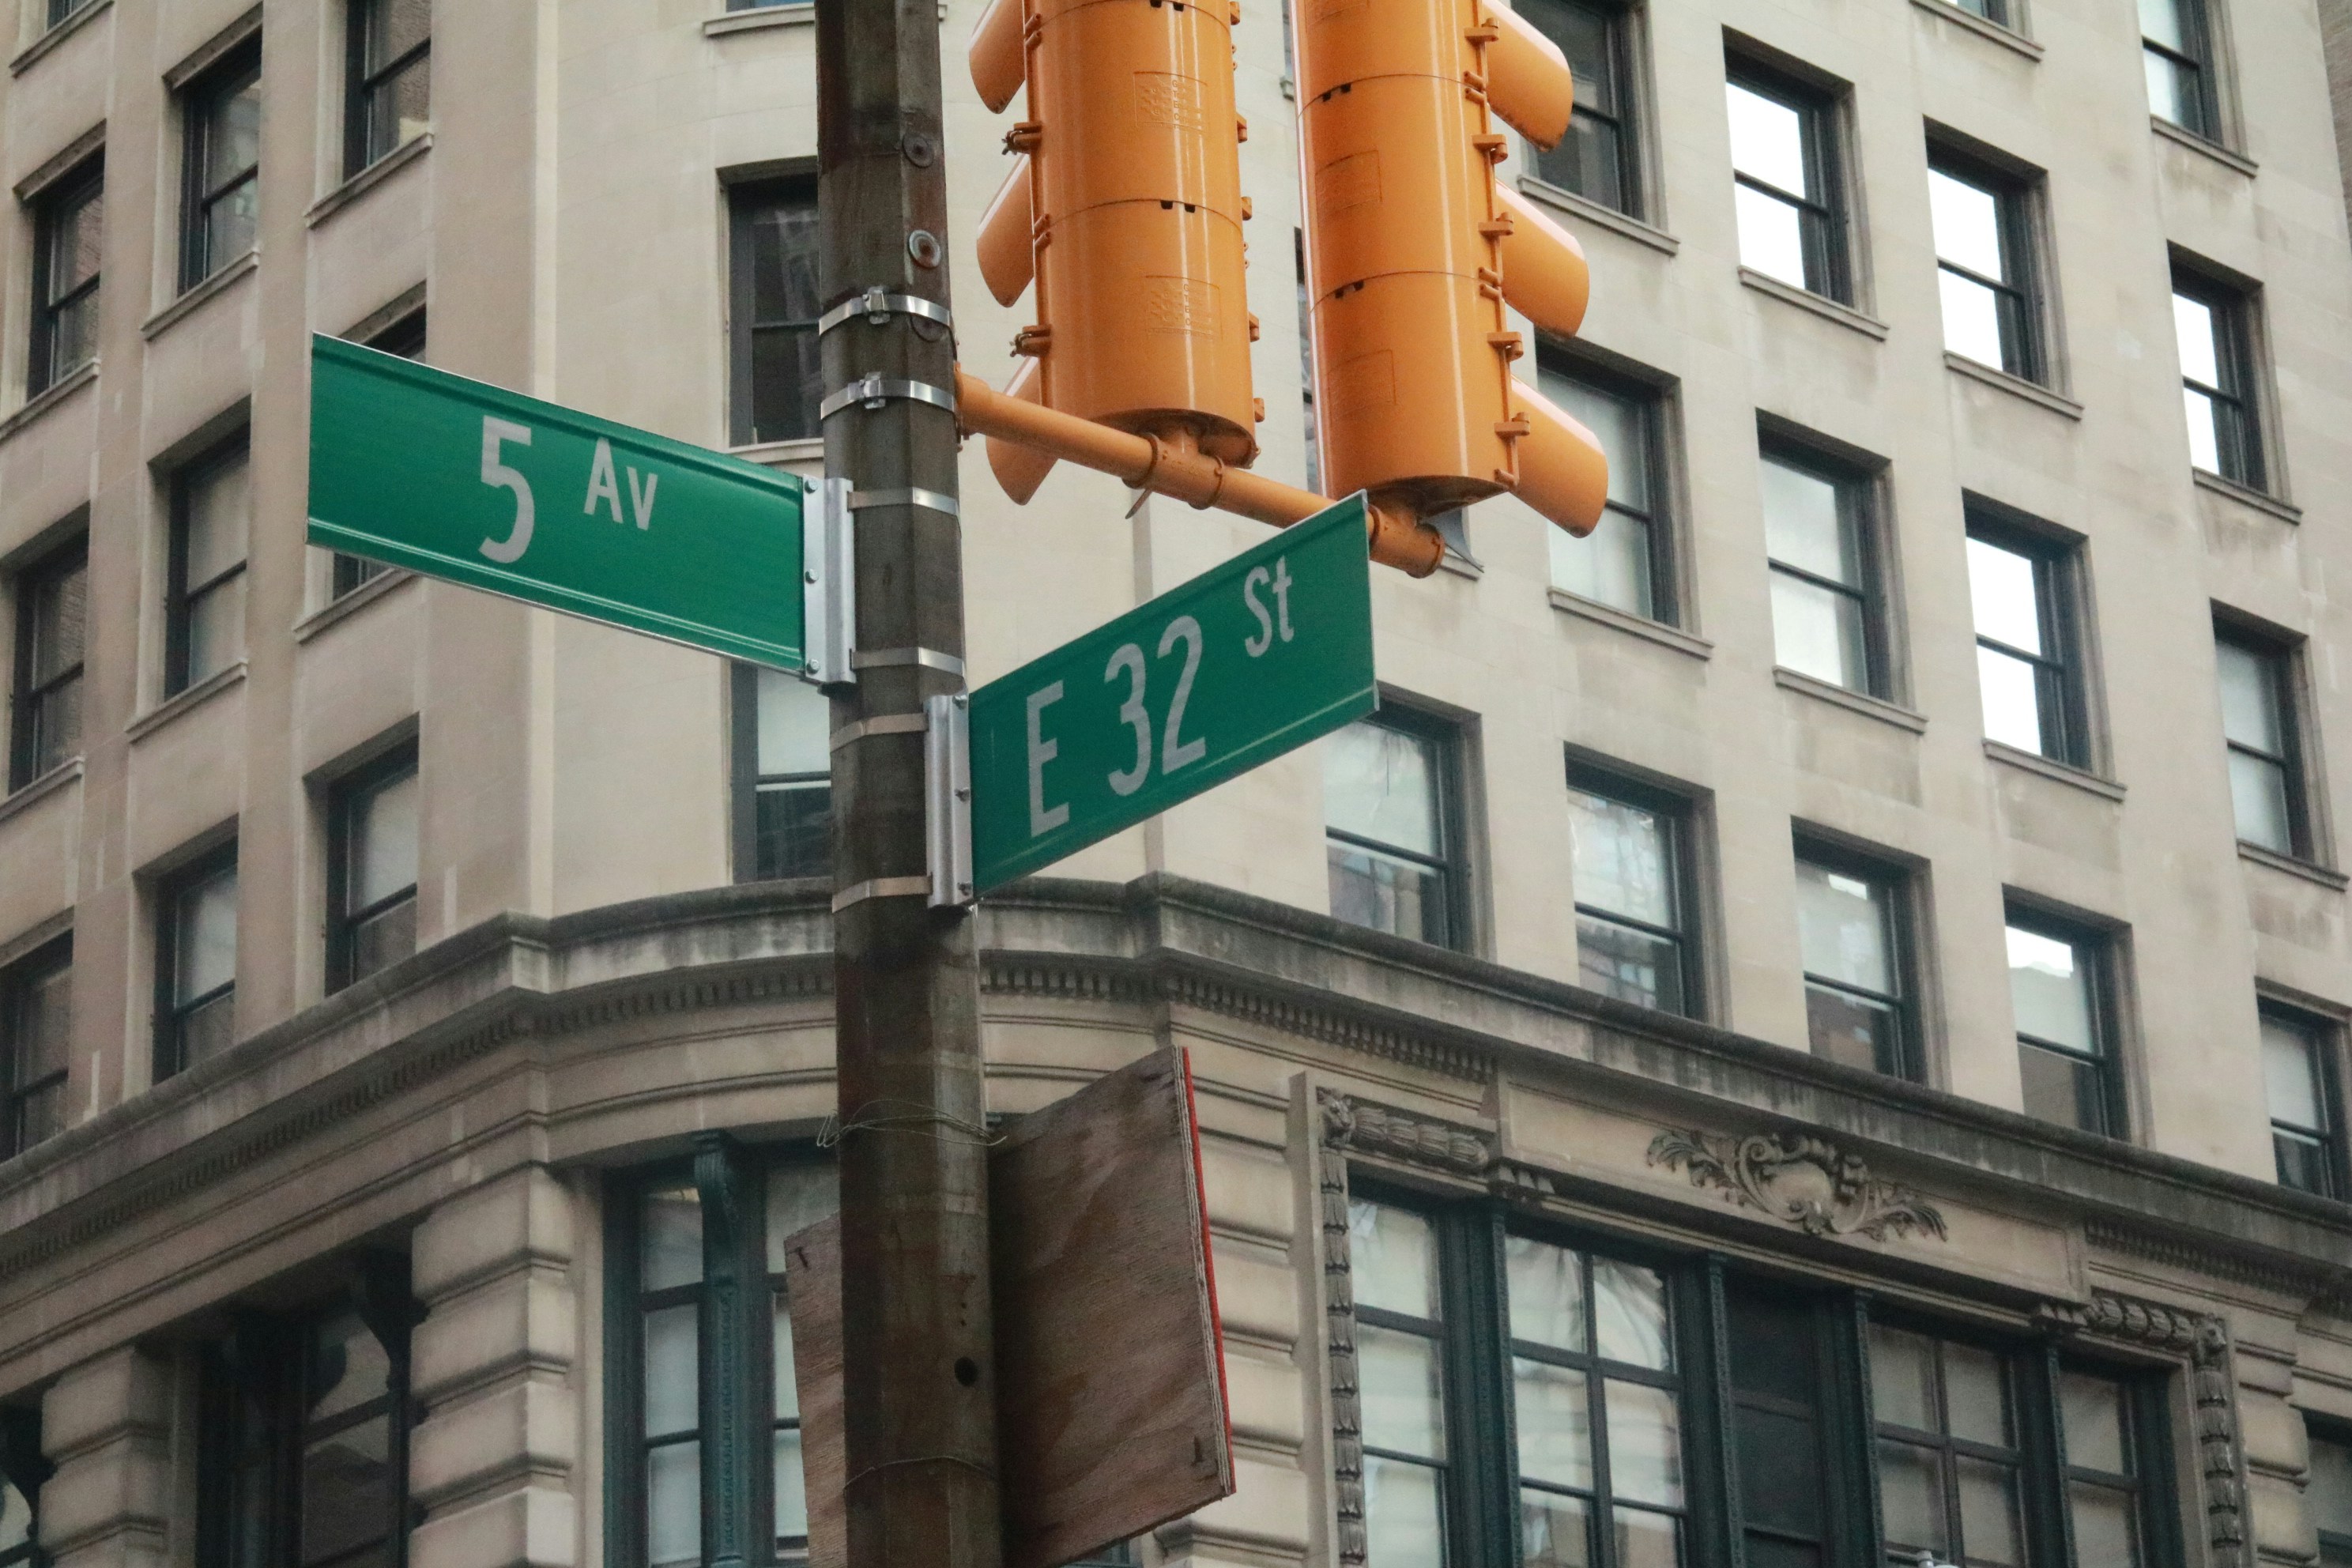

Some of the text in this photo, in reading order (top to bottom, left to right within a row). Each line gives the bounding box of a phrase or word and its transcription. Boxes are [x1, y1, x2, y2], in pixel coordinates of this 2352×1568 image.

[478, 415, 658, 564] 5 Av
[1027, 555, 1295, 838] E 32 St
